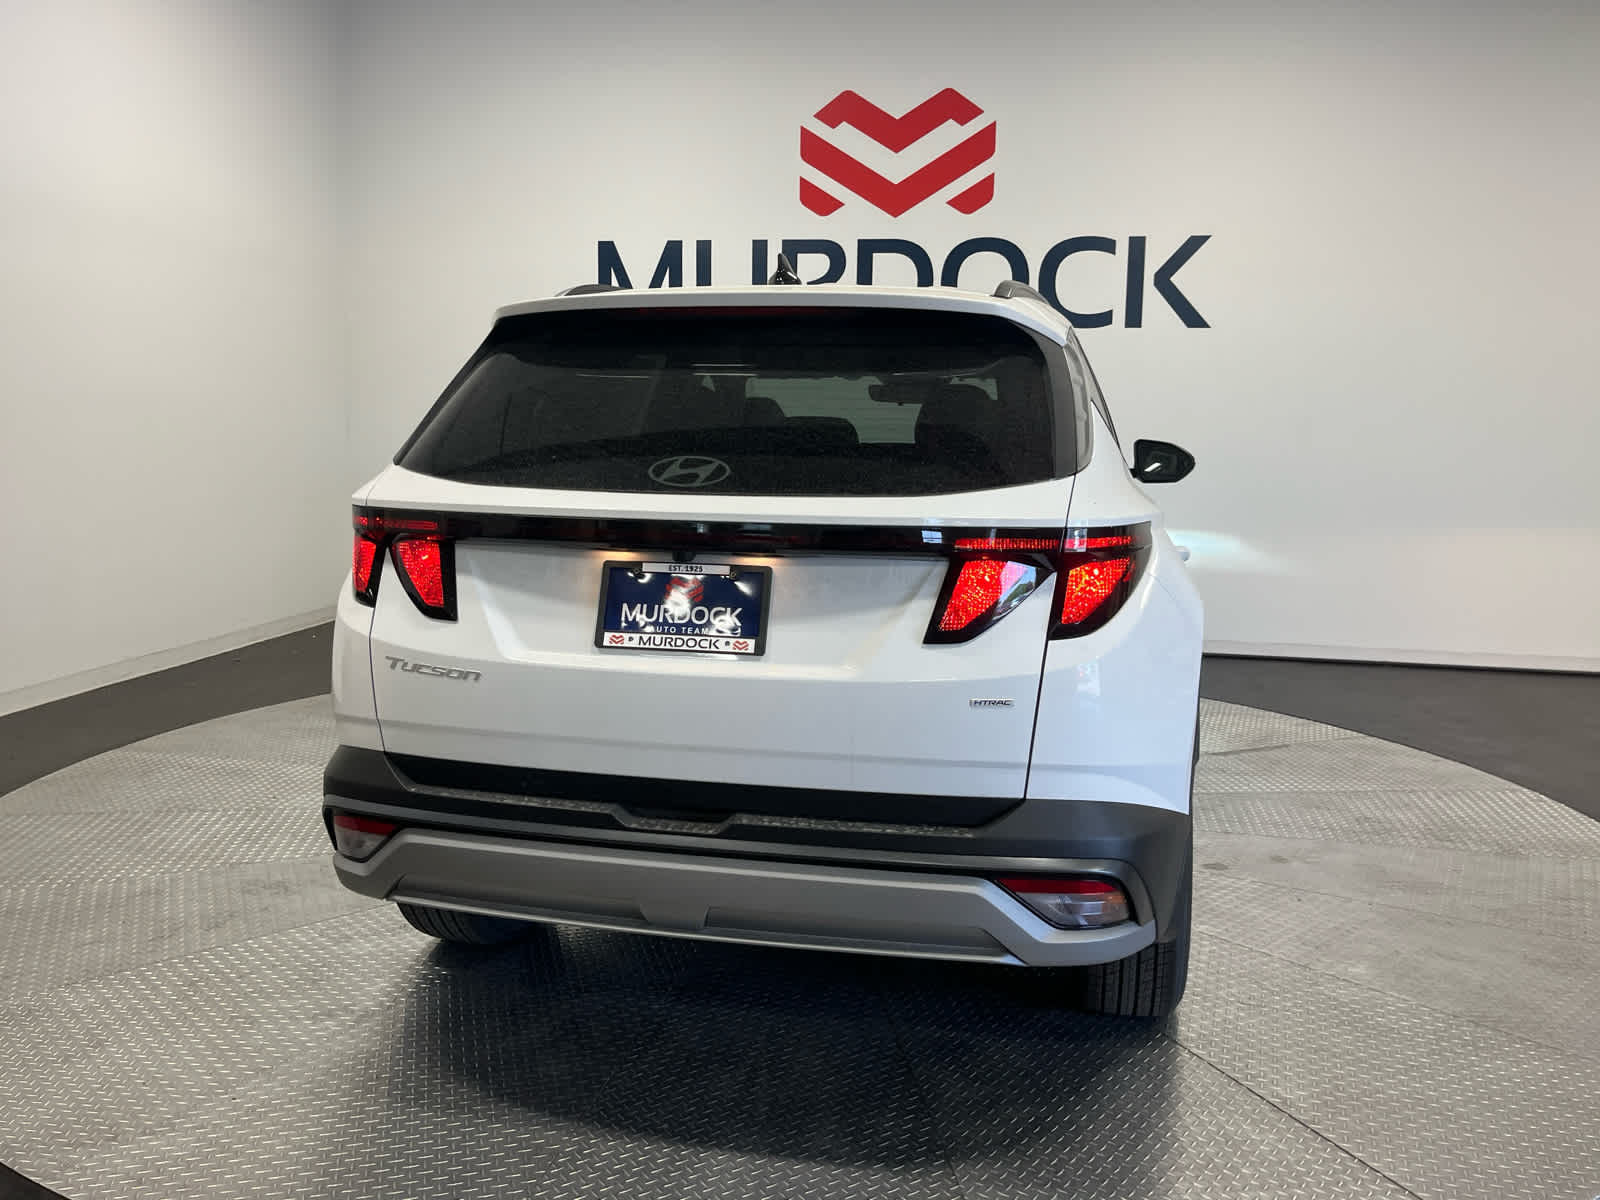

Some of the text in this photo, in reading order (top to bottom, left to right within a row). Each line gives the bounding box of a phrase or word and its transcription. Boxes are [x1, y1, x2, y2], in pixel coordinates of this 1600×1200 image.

[648, 625, 709, 635] UTO TEAM
[638, 635, 721, 650] MURDOCK
